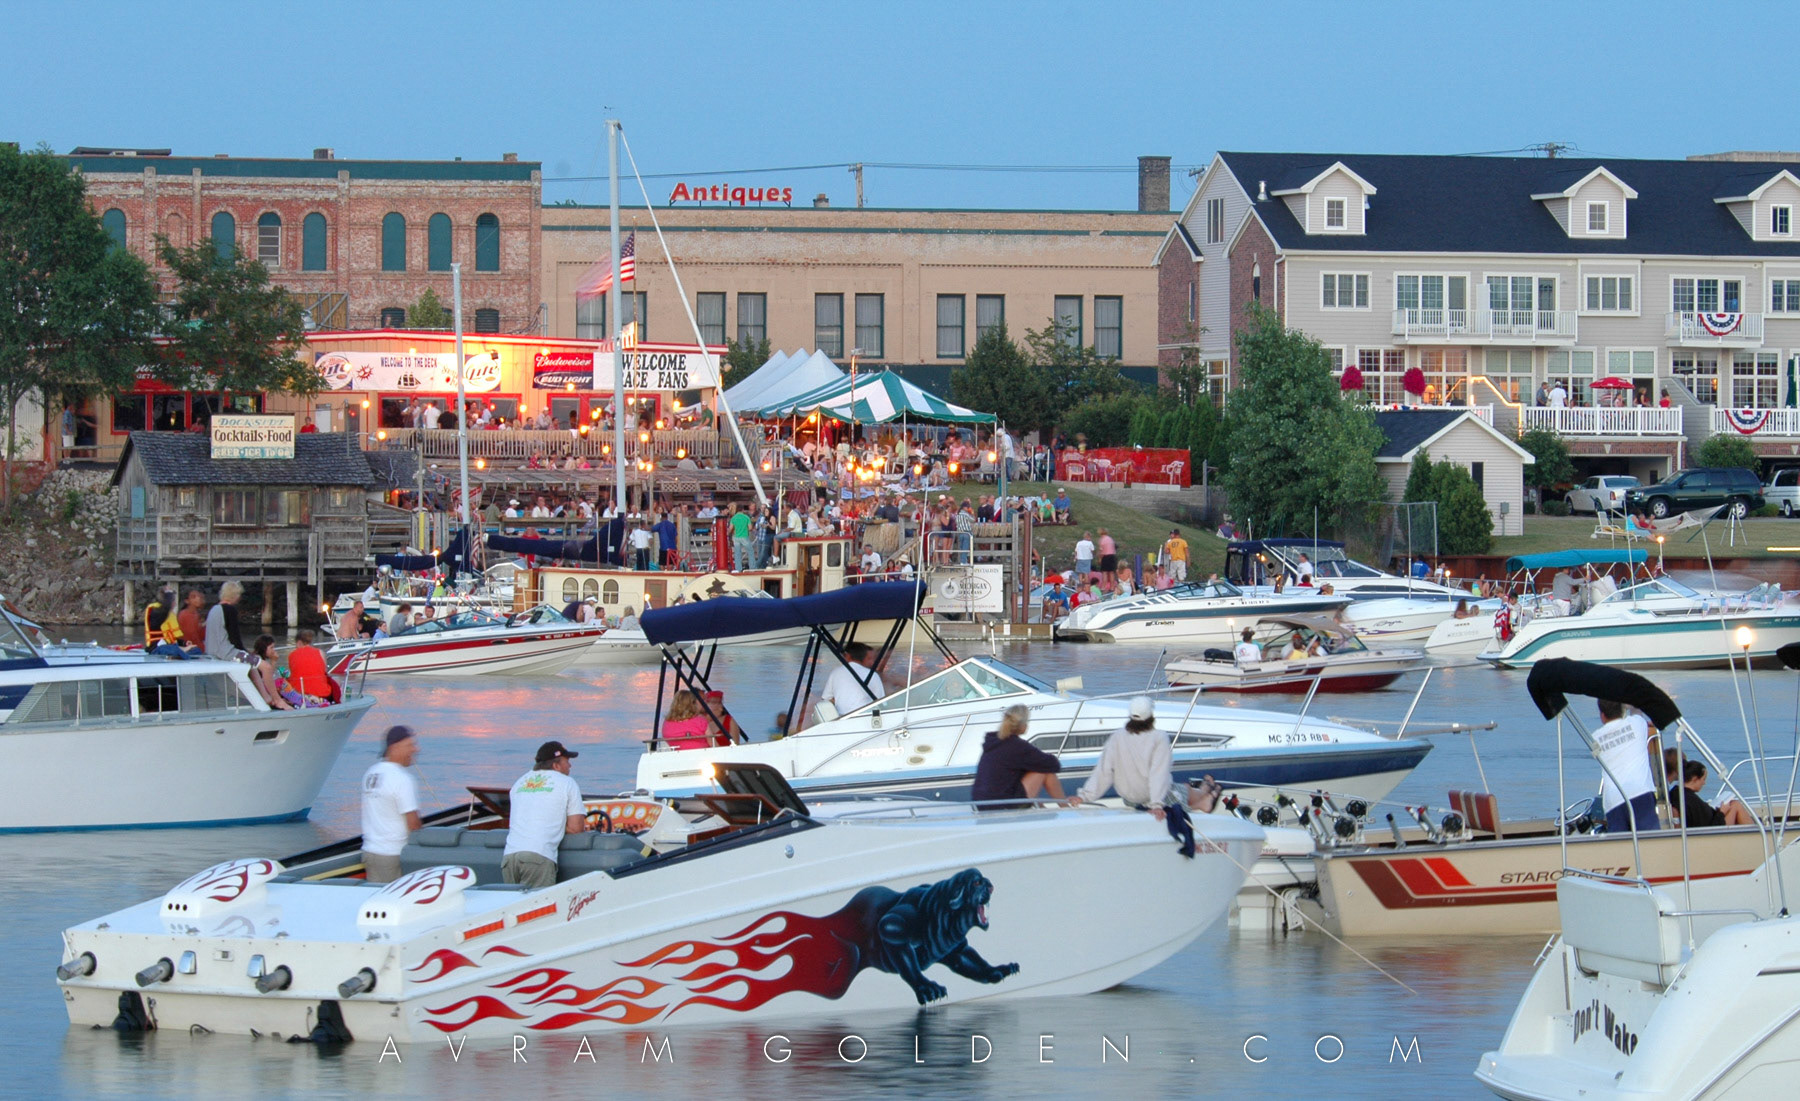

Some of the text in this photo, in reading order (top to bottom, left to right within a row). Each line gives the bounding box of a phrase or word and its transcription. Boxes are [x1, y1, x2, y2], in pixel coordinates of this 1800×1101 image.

[670, 182, 792, 206] Antiques
[380, 356, 438, 368] WELCOME TO THE DECK
[536, 355, 592, 368] Budweiser
[622, 353, 687, 370] WELCOME
[466, 364, 498, 381] Lite
[540, 375, 593, 384] BUD LIGHT
[623, 371, 689, 389] ACE FANS
[214, 429, 292, 442] Cocktails Food
[1268, 734, 1282, 743] MC
[1309, 732, 1322, 742] RB
[1573, 998, 1639, 1057] Don't Wake
